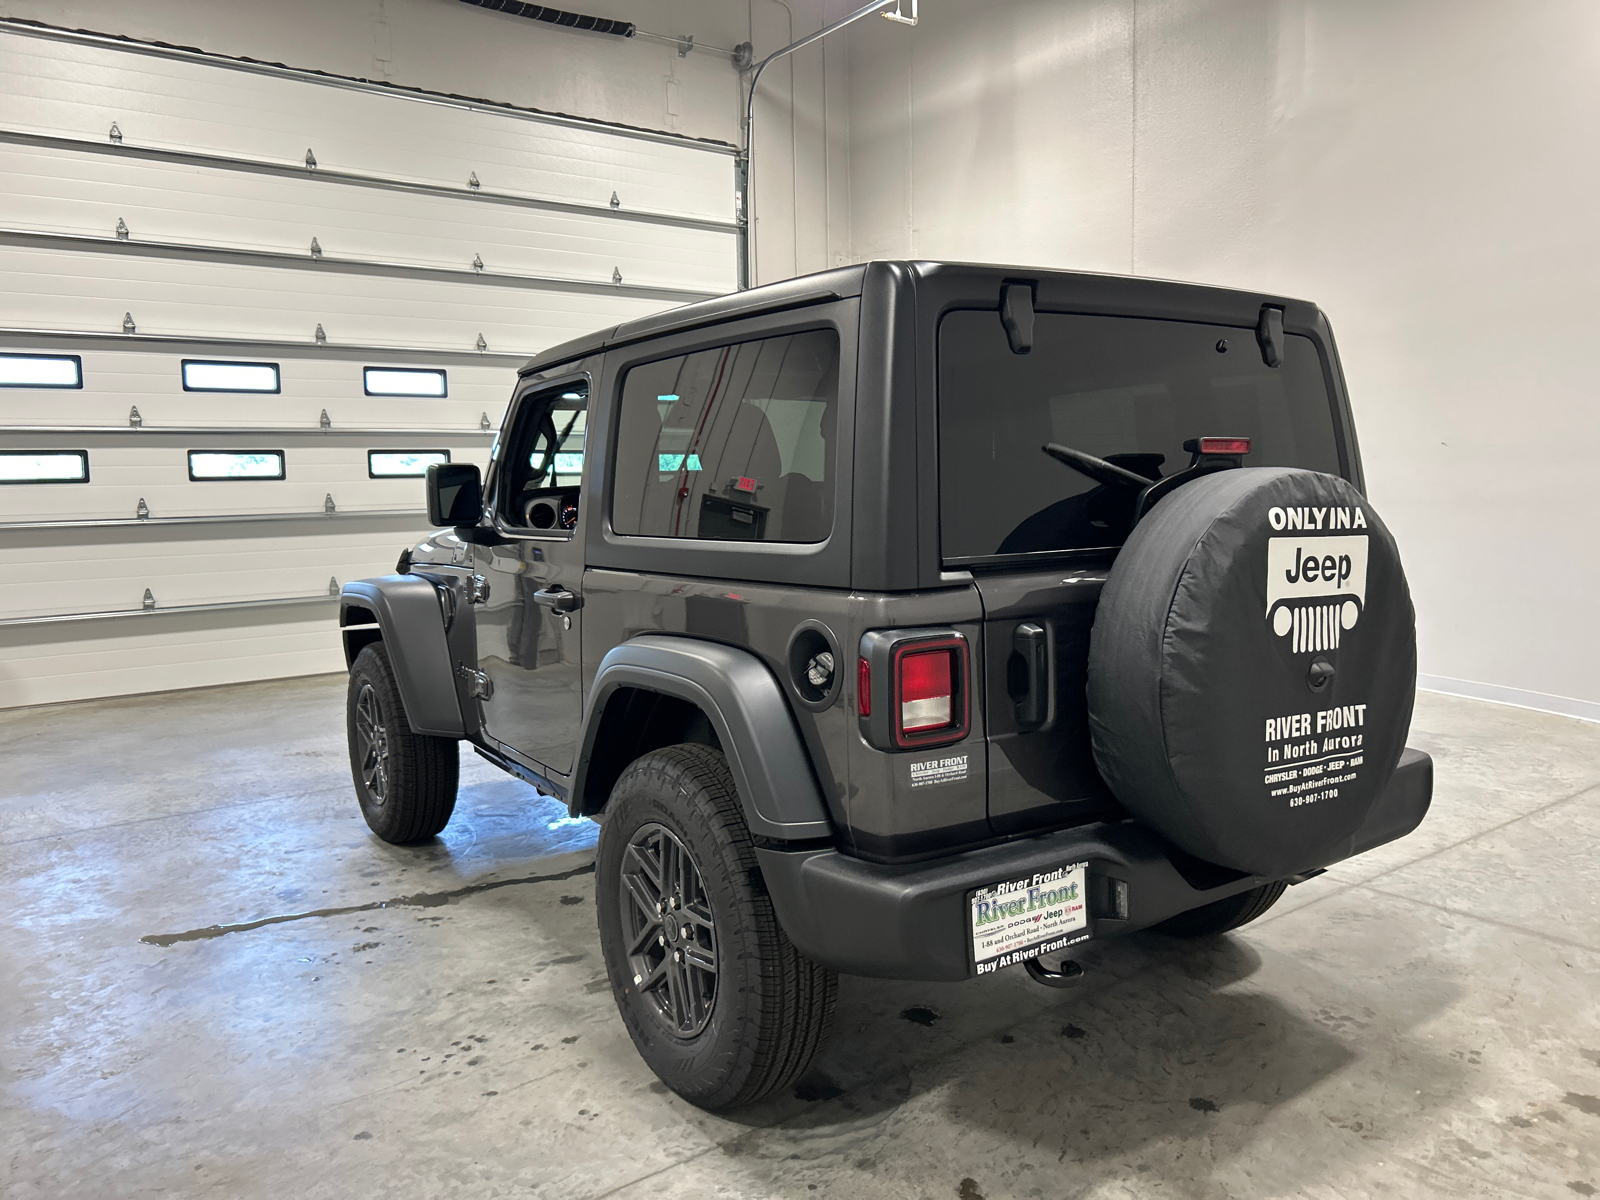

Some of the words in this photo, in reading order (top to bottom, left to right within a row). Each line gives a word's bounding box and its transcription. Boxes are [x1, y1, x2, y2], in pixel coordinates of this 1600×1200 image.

[1268, 506, 1327, 531] ONLY
[1329, 506, 1351, 530] IN
[1352, 506, 1368, 529] A
[1285, 547, 1351, 589] Jeep
[1265, 713, 1311, 742] RIVER
[1316, 703, 1367, 734] FRONT
[1267, 747, 1279, 763] In
[1283, 740, 1318, 760] North
[1322, 734, 1363, 753] Aurora
[910, 760, 939, 772] RIVER
[940, 755, 968, 768] FRONT
[1264, 770, 1298, 784] CHRYSLER
[1302, 764, 1323, 777] DODGE
[1327, 760, 1345, 771] JEEP
[1350, 755, 1364, 767] RAM
[1270, 772, 1357, 797] www.BuyAtRiverFront.com
[1289, 788, 1339, 808] 630-907-1700
[997, 878, 1030, 896] River
[1032, 867, 1063, 886] Front
[975, 894, 1027, 927] River
[1026, 880, 1079, 913] Front
[1043, 908, 1063, 920] Jeep
[1071, 904, 1083, 912] RAM
[1005, 929, 1026, 942] Orchard
[1026, 925, 1040, 935] Road
[1042, 920, 1058, 930] North
[976, 960, 998, 975] Buy
[999, 955, 1012, 968] At
[1012, 947, 1040, 963] River
